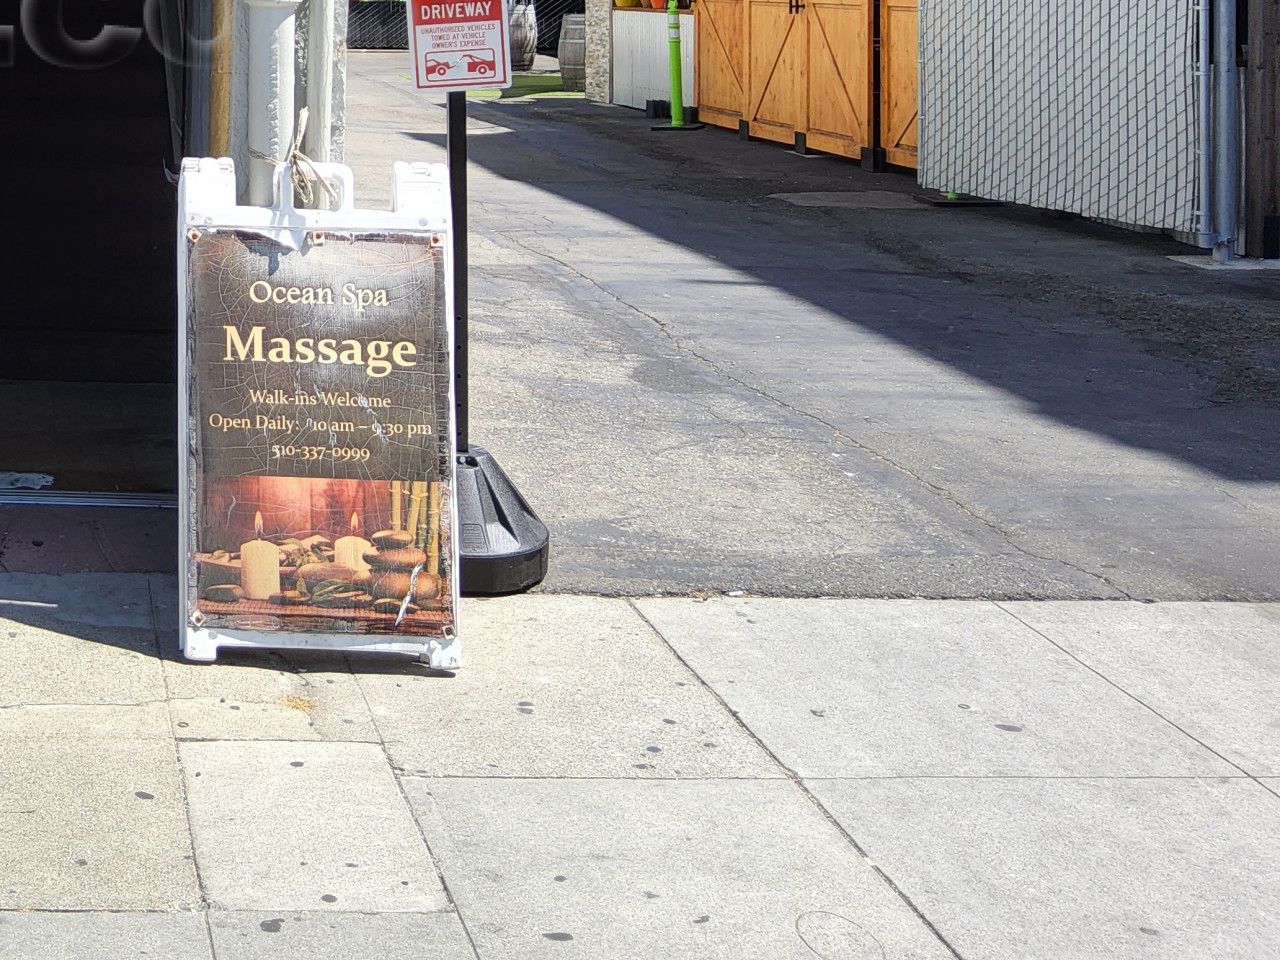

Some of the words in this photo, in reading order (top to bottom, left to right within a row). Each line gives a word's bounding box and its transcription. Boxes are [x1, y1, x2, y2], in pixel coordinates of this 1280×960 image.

[421, 1, 492, 20] DRIVEWAY
[420, 25, 465, 34] UNAUTHORIZED
[467, 23, 496, 32] VEHICLES
[431, 33, 451, 42] TOWED
[461, 31, 487, 40] VEHICLE
[432, 41, 458, 49] OWNER'S
[460, 39, 487, 48] EXPENSE
[249, 280, 334, 305] Ocean
[342, 282, 390, 312] Spa
[223, 325, 418, 378] Massage
[249, 389, 317, 405] Walk-ins
[209, 413, 251, 432] Open
[256, 415, 300, 434] Daily:
[313, 421, 327, 431] 10
[332, 421, 355, 432] am
[407, 424, 432, 438] pm
[271, 445, 370, 461] 510-337-0999
